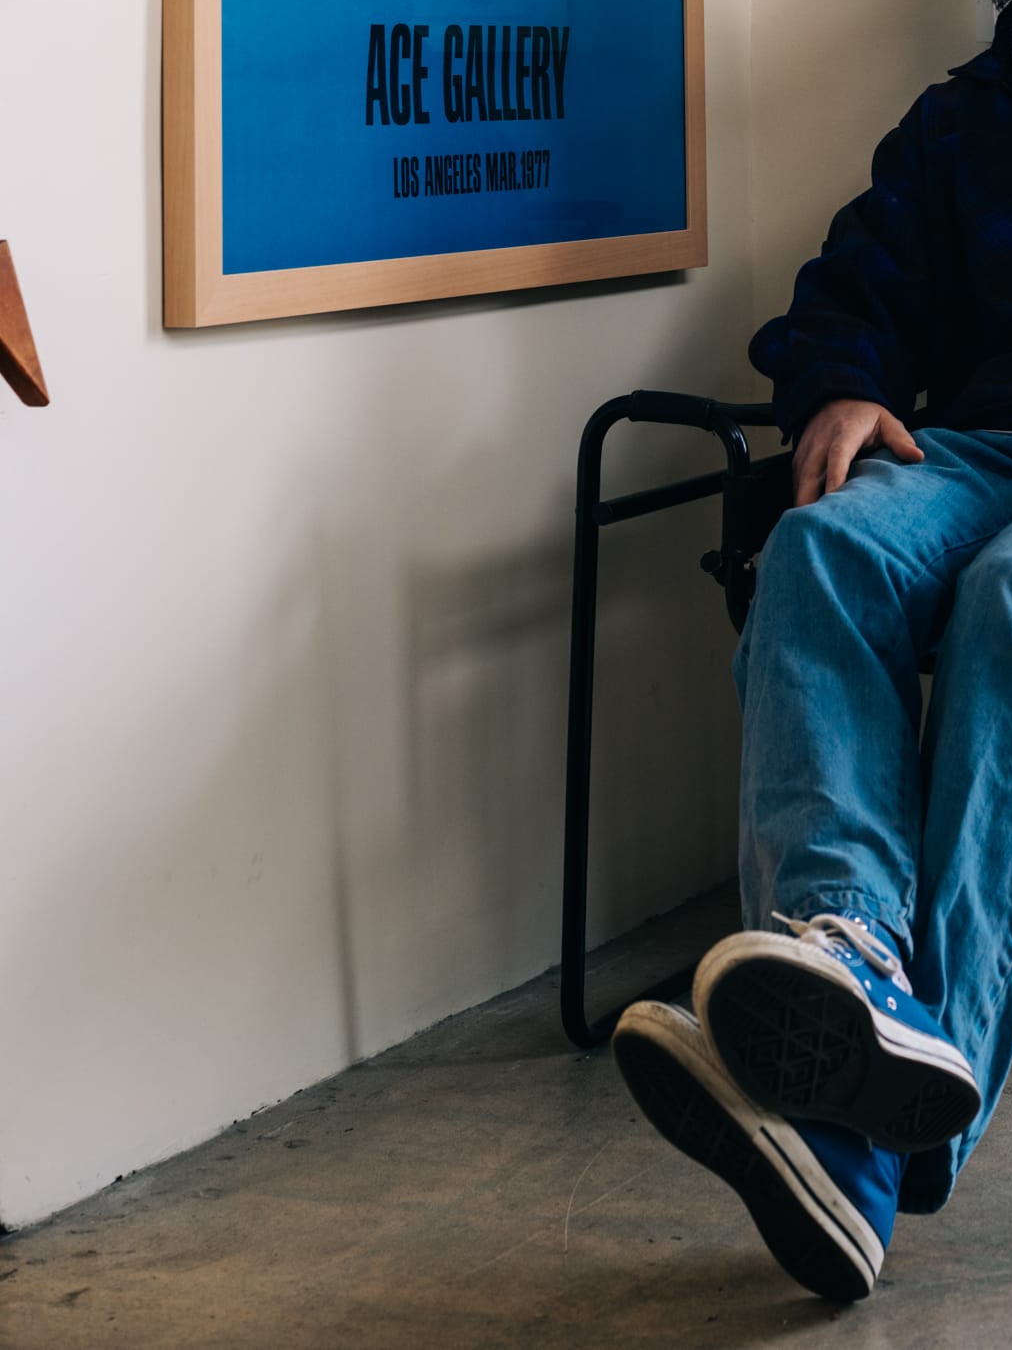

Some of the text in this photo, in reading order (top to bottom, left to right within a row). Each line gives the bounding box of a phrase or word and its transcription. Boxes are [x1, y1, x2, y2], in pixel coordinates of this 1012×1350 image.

[365, 23, 570, 126] ACE GALLERY
[393, 155, 420, 199] LOS
[424, 153, 482, 197] ANGELES
